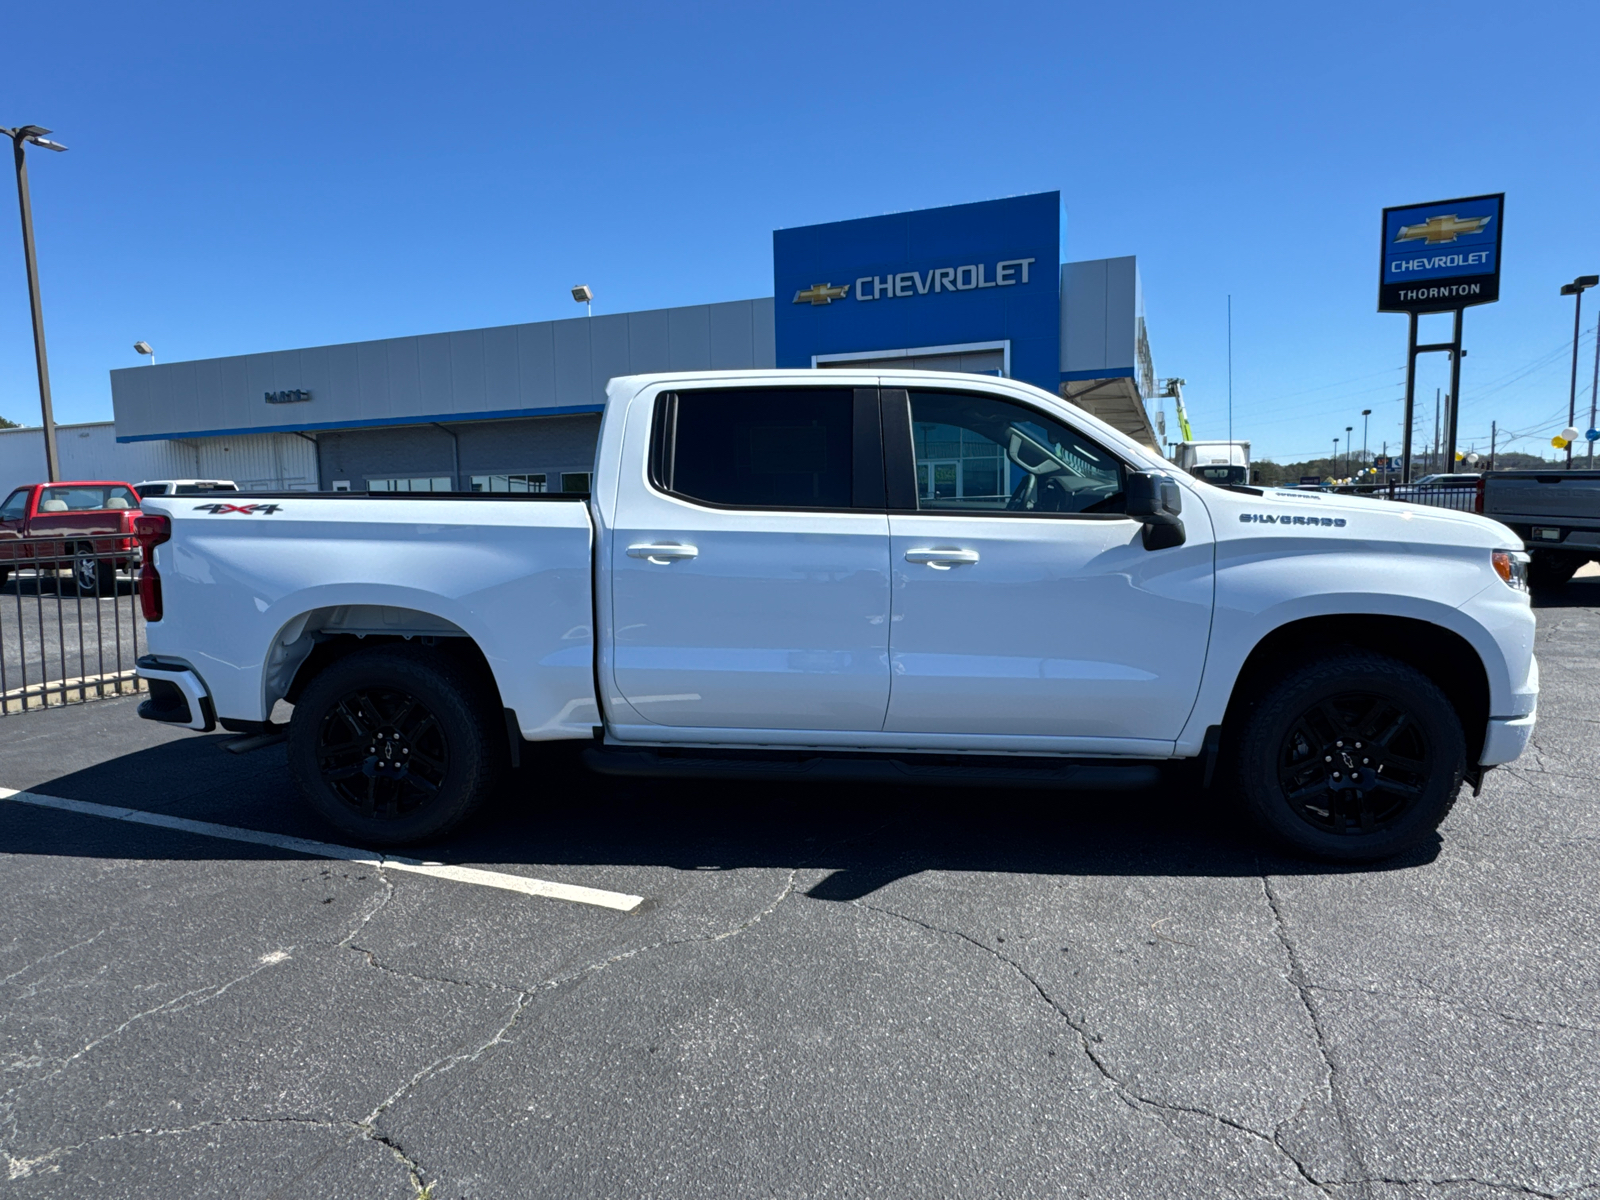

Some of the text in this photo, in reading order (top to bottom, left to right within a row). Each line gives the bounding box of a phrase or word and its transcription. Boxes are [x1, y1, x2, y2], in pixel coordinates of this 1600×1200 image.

[1391, 251, 1490, 273] CHEVROLET
[855, 257, 1036, 301] CHEVROLET
[1398, 283, 1480, 301] THORNTON
[1239, 513, 1347, 528] SILVERADO
